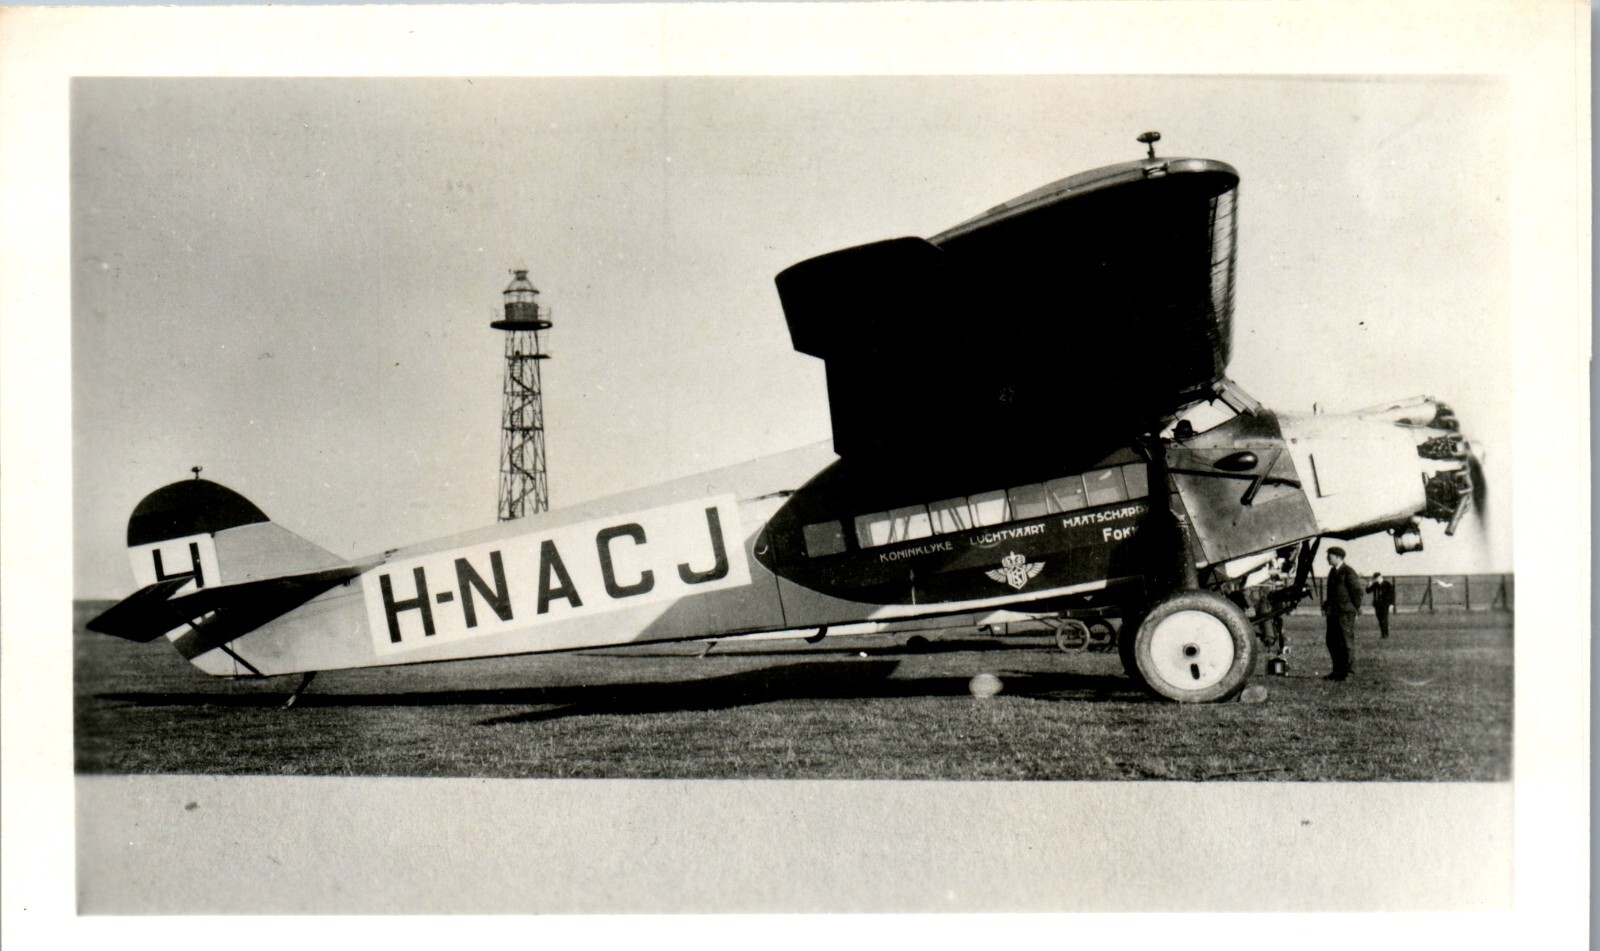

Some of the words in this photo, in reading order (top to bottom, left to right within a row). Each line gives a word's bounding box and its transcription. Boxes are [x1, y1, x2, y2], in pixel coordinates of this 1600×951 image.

[152, 542, 204, 588] H
[879, 541, 953, 563] KONINKLYKE
[969, 523, 1046, 545] LUCHTVAART
[379, 506, 729, 643] H-NACJ
